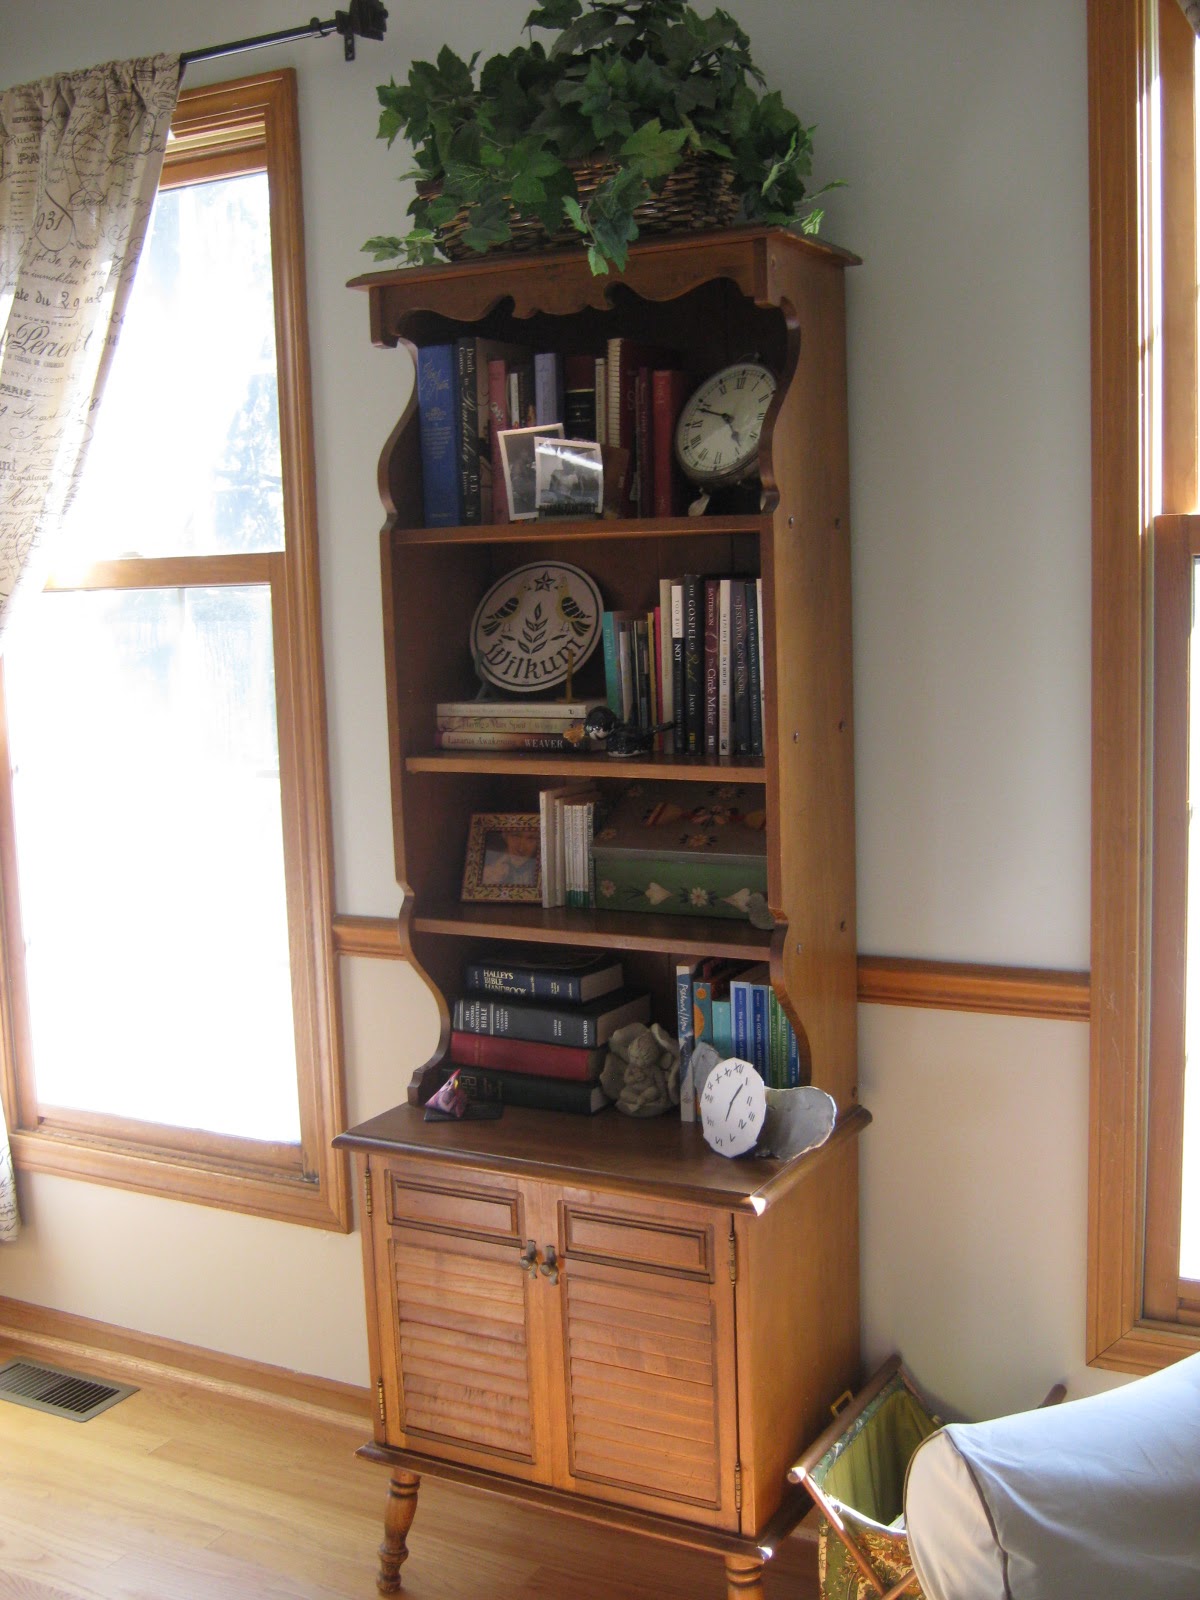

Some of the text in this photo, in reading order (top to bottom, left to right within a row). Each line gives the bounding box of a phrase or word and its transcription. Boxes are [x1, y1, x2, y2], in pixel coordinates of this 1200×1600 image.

[466, 348, 475, 374] Death
[461, 387, 477, 463] Pemberley
[688, 599, 697, 641] GOSPEL
[733, 603, 743, 624] JESUS
[735, 624, 743, 641] YOU
[483, 637, 586, 680] Wilkum
[674, 642, 682, 662] NOT
[706, 668, 718, 694] Circle
[736, 665, 746, 696] IGNORE
[688, 693, 697, 716] JAMES
[706, 696, 718, 725] Maker
[525, 738, 564, 749] WEAVER
[485, 978, 504, 987] BIBLE
[480, 1008, 488, 1029] BIBLE
